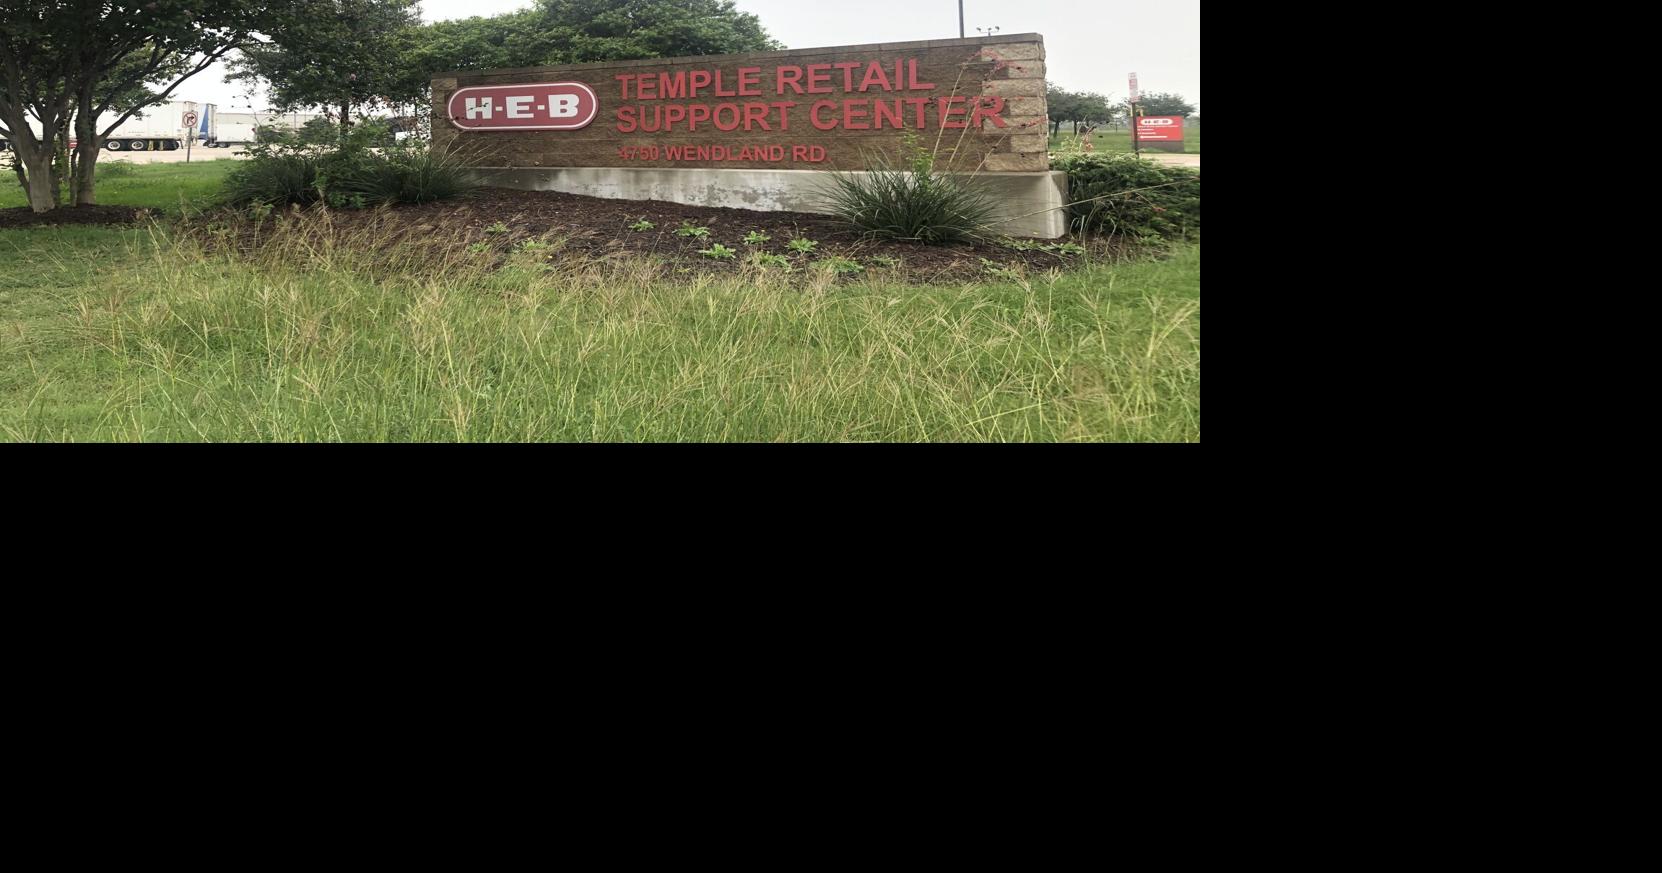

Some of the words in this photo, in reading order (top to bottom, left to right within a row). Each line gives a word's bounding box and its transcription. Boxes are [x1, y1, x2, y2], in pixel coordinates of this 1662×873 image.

[615, 66, 762, 100] TEMPLE
[776, 58, 936, 95] RETAIL
[465, 93, 580, 120] H-E-B
[616, 101, 797, 133] SUPPORT
[809, 95, 1007, 130] CENTER
[618, 145, 659, 160] 4750
[664, 144, 785, 162] WENDLAND
